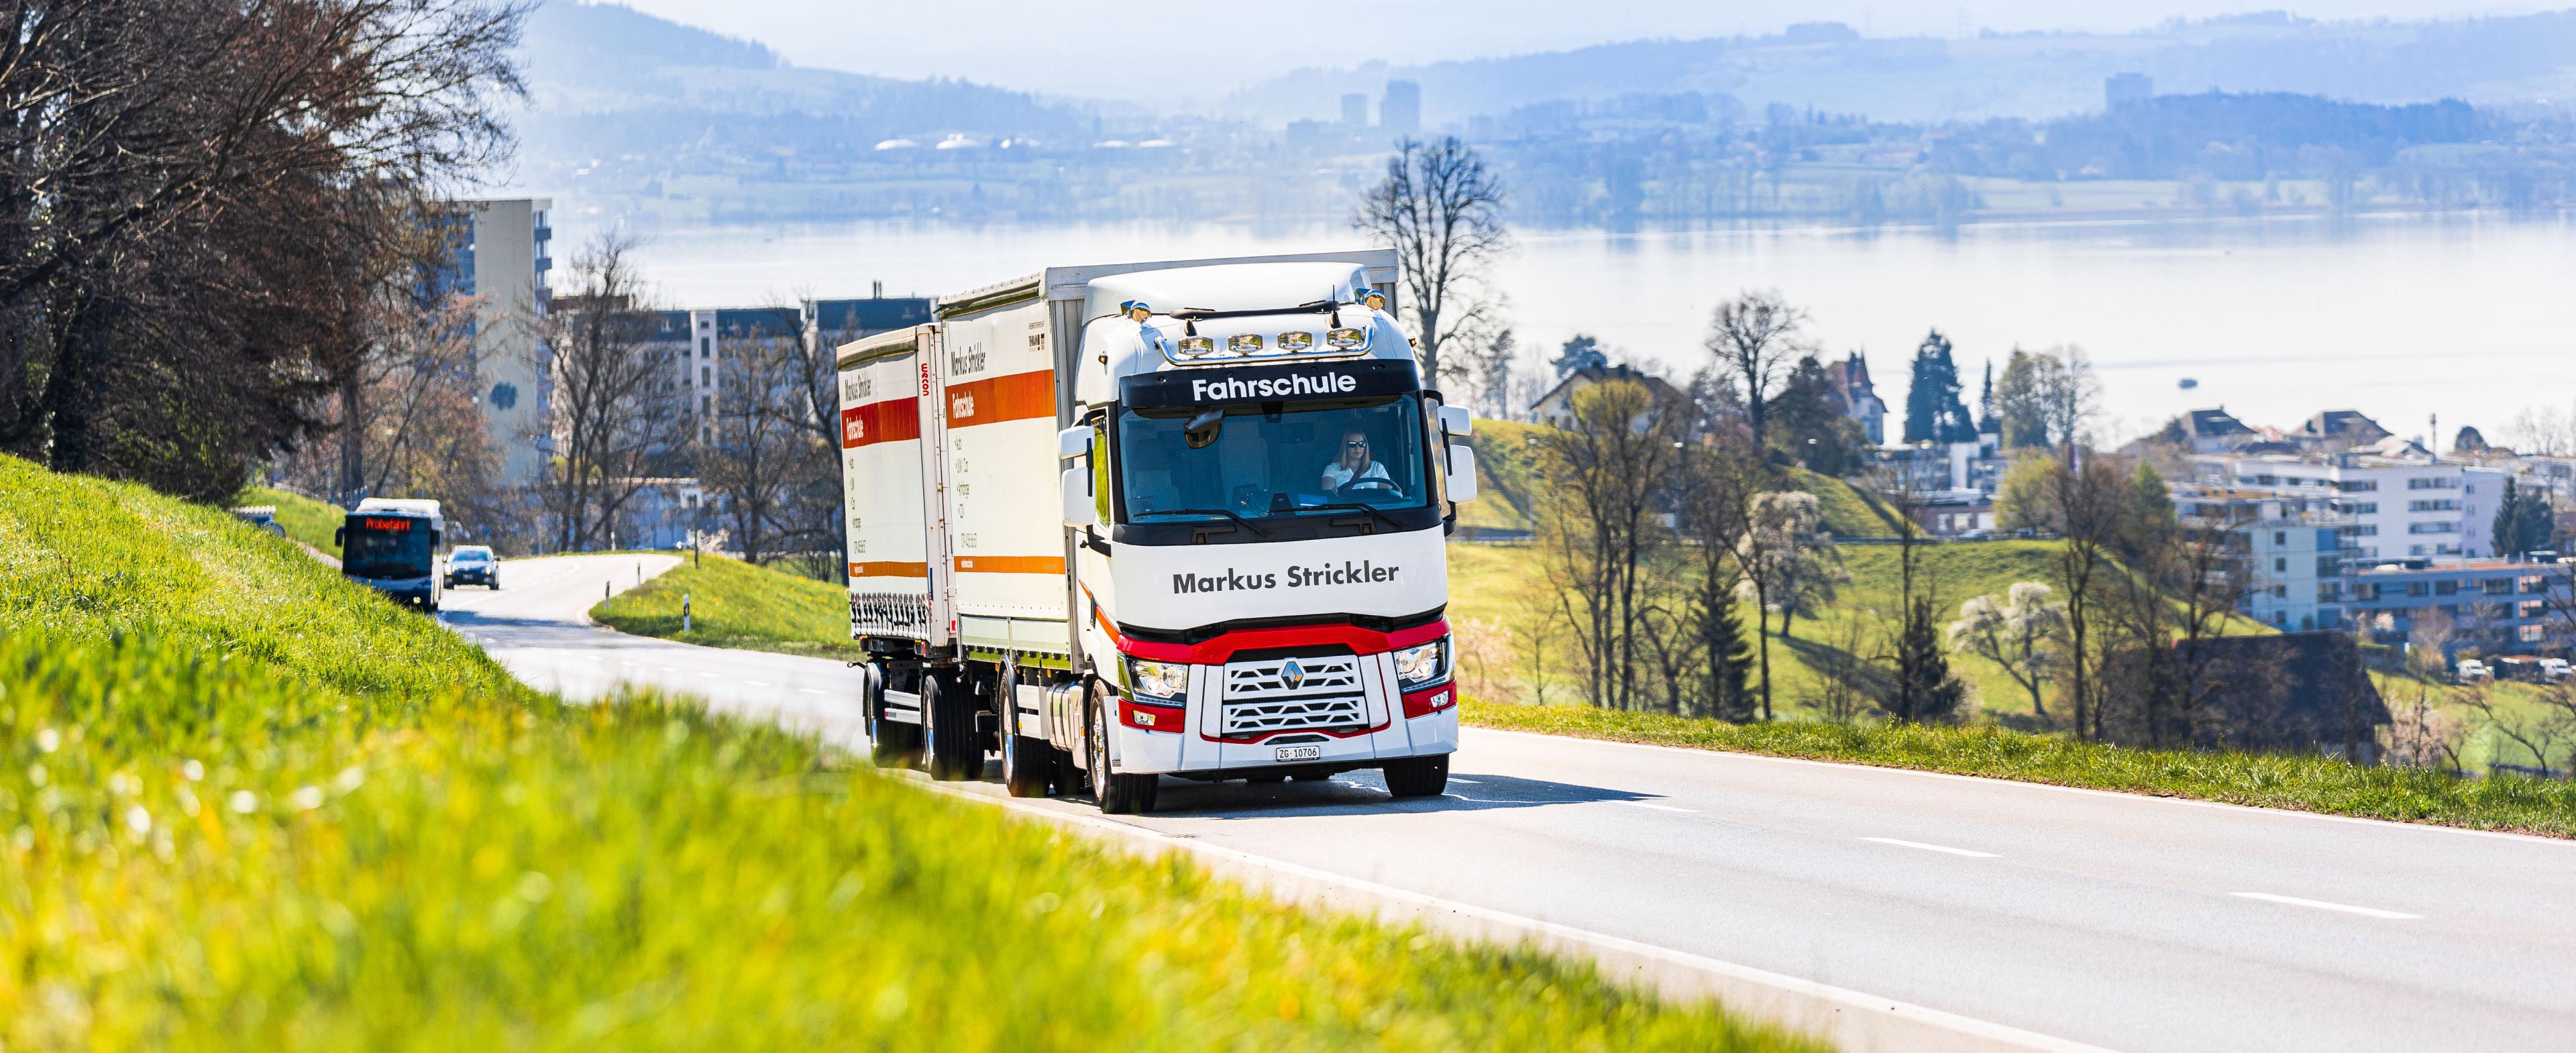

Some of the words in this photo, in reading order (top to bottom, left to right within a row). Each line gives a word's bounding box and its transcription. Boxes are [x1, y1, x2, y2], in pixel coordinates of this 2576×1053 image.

[951, 345, 967, 377] Markus
[968, 341, 985, 374] Strickler
[921, 363, 929, 396] wecon
[1191, 372, 1356, 401] Fahrschule
[953, 390, 974, 419] Fahrschule
[846, 414, 864, 441] Fahrschule
[366, 516, 411, 532] Probefahrt
[1173, 568, 1277, 594] Markus
[1287, 560, 1399, 588] Strickler
